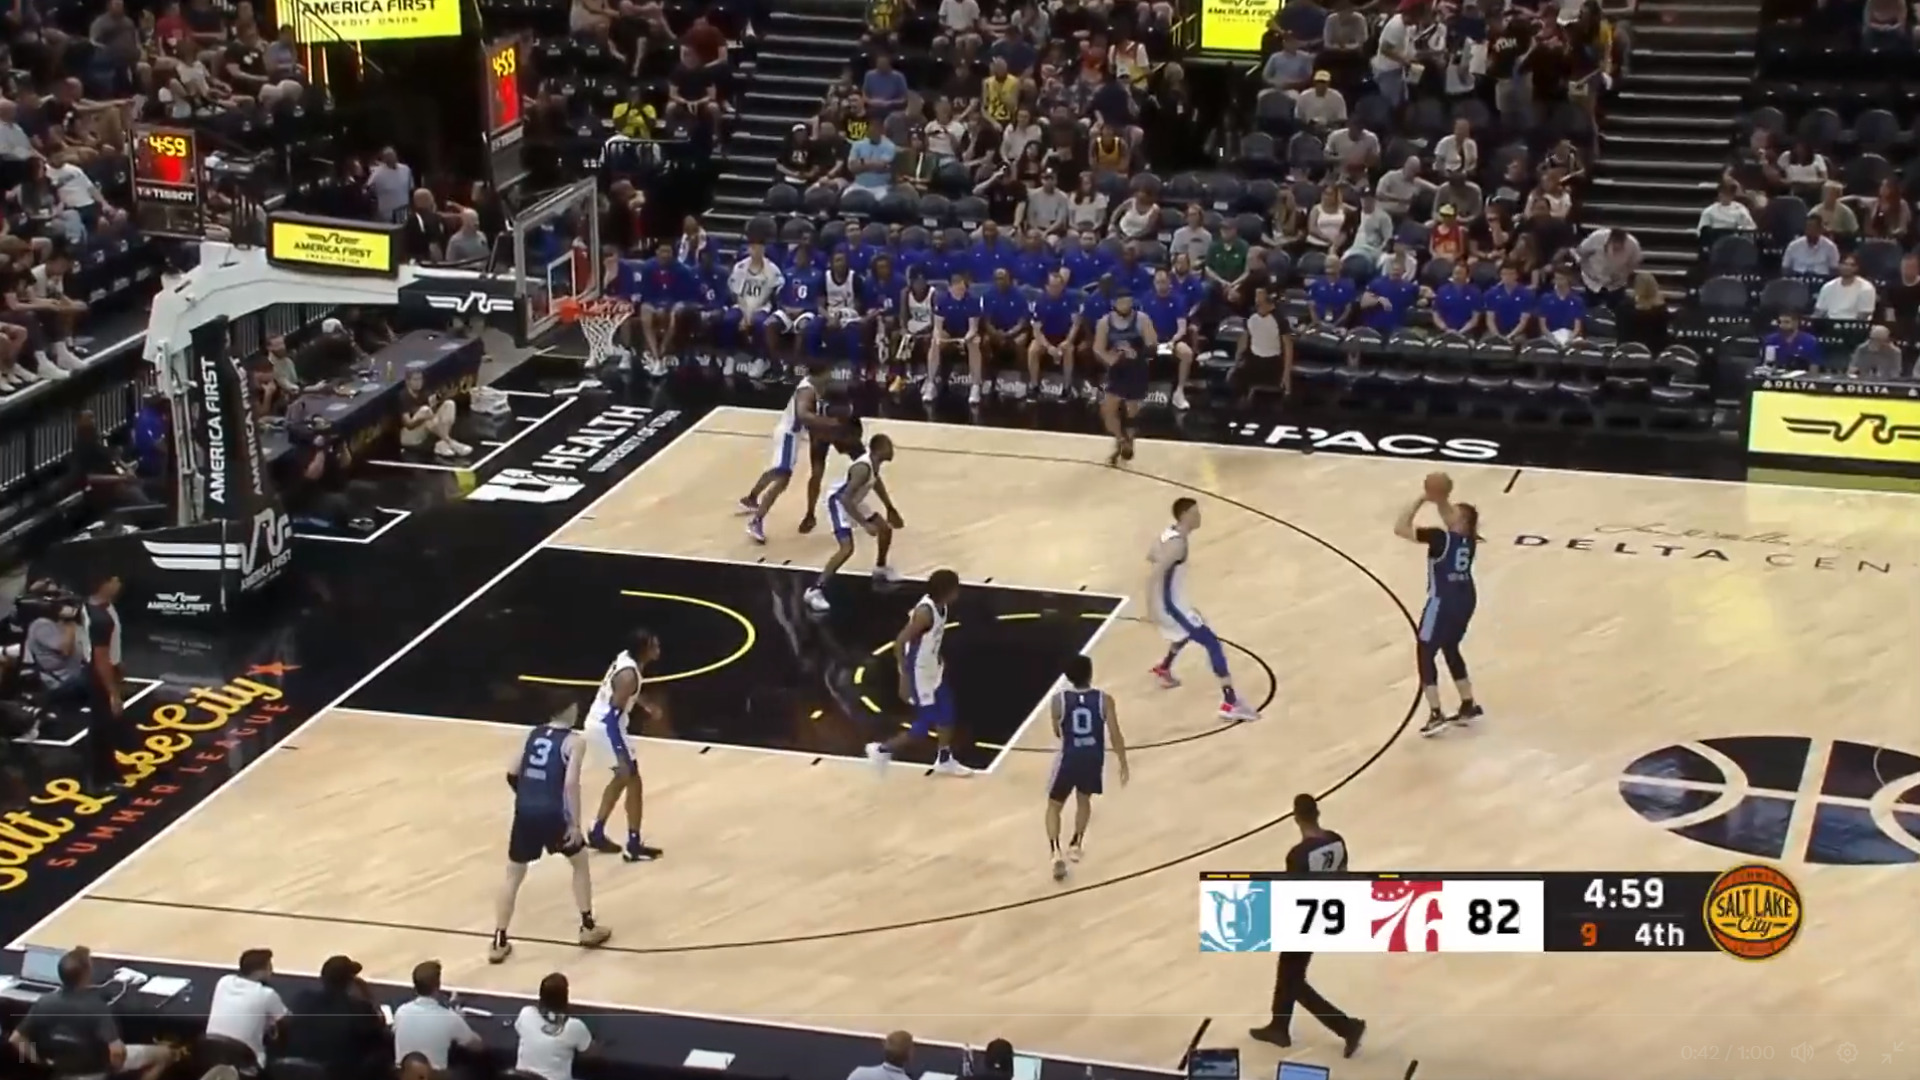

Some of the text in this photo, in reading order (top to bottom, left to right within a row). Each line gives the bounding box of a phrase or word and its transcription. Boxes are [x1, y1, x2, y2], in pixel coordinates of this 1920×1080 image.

[302, 0, 436, 15] AMERICA FIRST
[149, 136, 187, 157] 4:59
[293, 241, 372, 258] AMERICA FIRST
[1775, 381, 1817, 390] DELTA
[1846, 385, 1890, 395] DELTA
[200, 355, 225, 504] AMERICA FIRST
[532, 405, 653, 469] HEALTH
[1265, 425, 1500, 460] PACS
[1455, 547, 1469, 572] 6
[1513, 534, 1729, 562] DELTA
[147, 602, 212, 612] AMERICA FIRST
[137, 677, 284, 731] City
[1073, 707, 1092, 735] 0
[529, 737, 553, 767] 3
[47, 702, 291, 867] SUMMER LEAGUE
